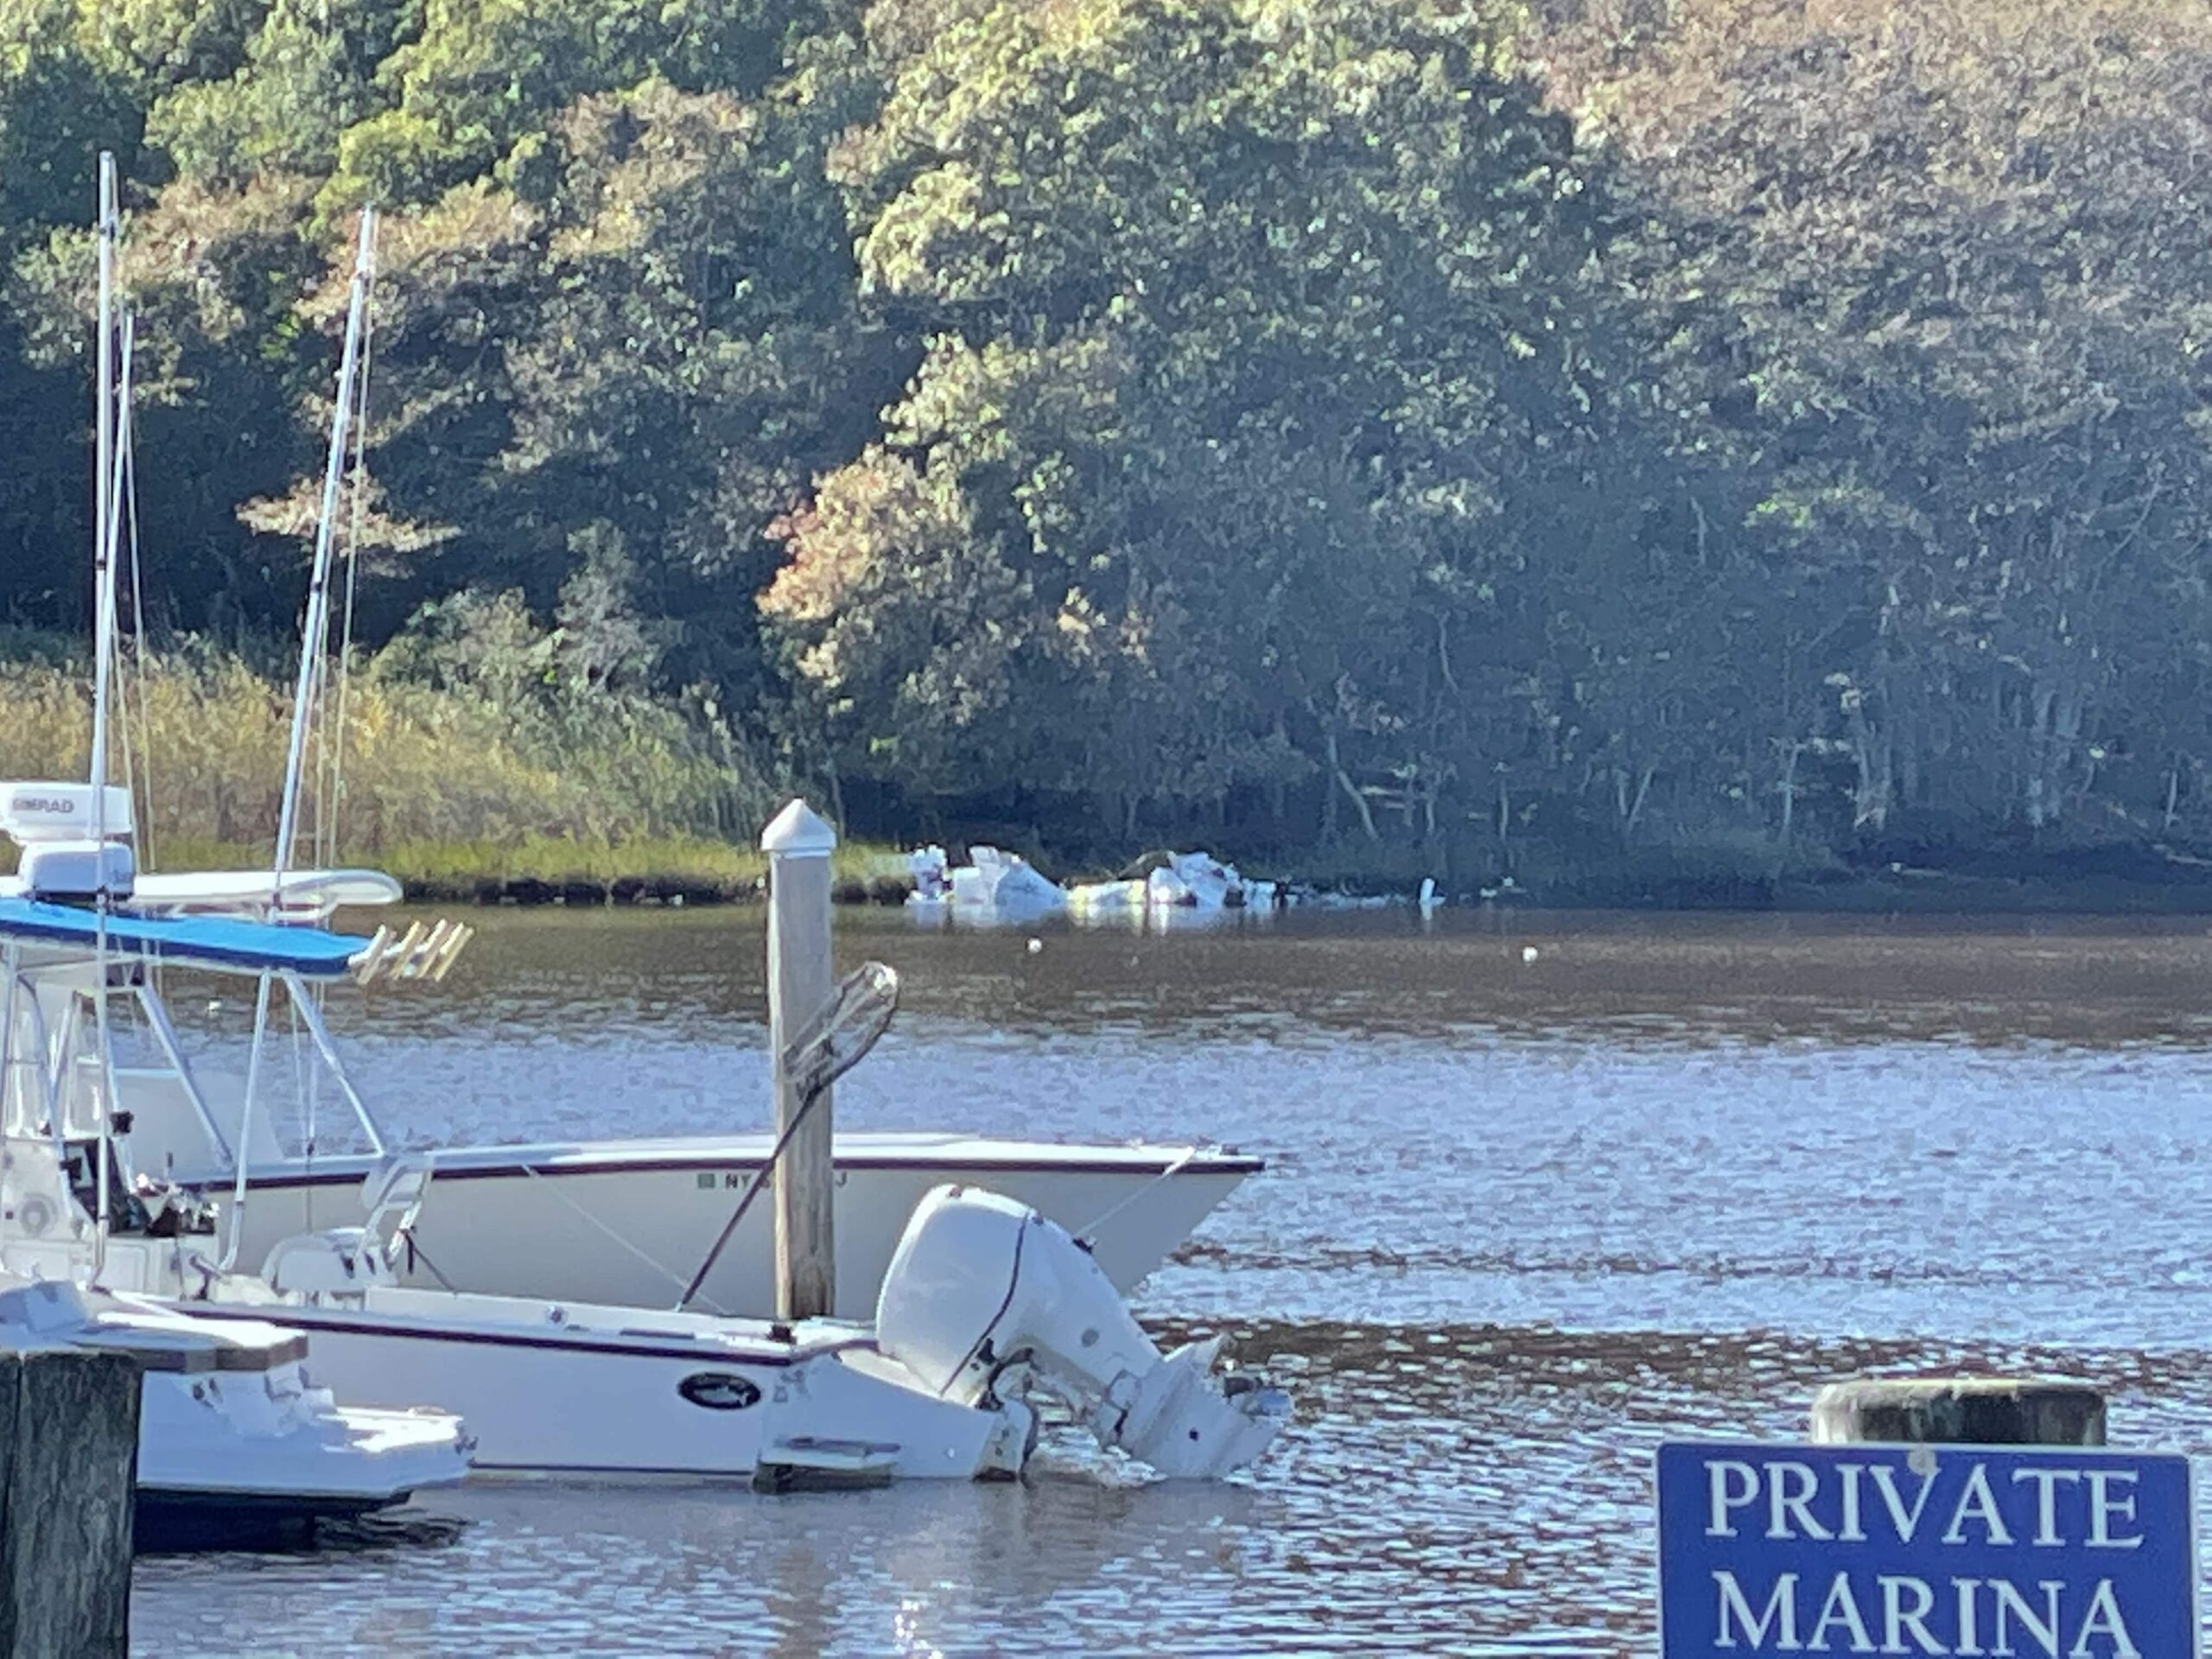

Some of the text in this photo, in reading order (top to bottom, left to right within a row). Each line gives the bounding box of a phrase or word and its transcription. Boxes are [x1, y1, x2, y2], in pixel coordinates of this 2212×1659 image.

[726, 1173, 751, 1188] NY
[1704, 1461, 2145, 1548] PRIVATE
[1712, 1571, 2141, 1659] MARINA
